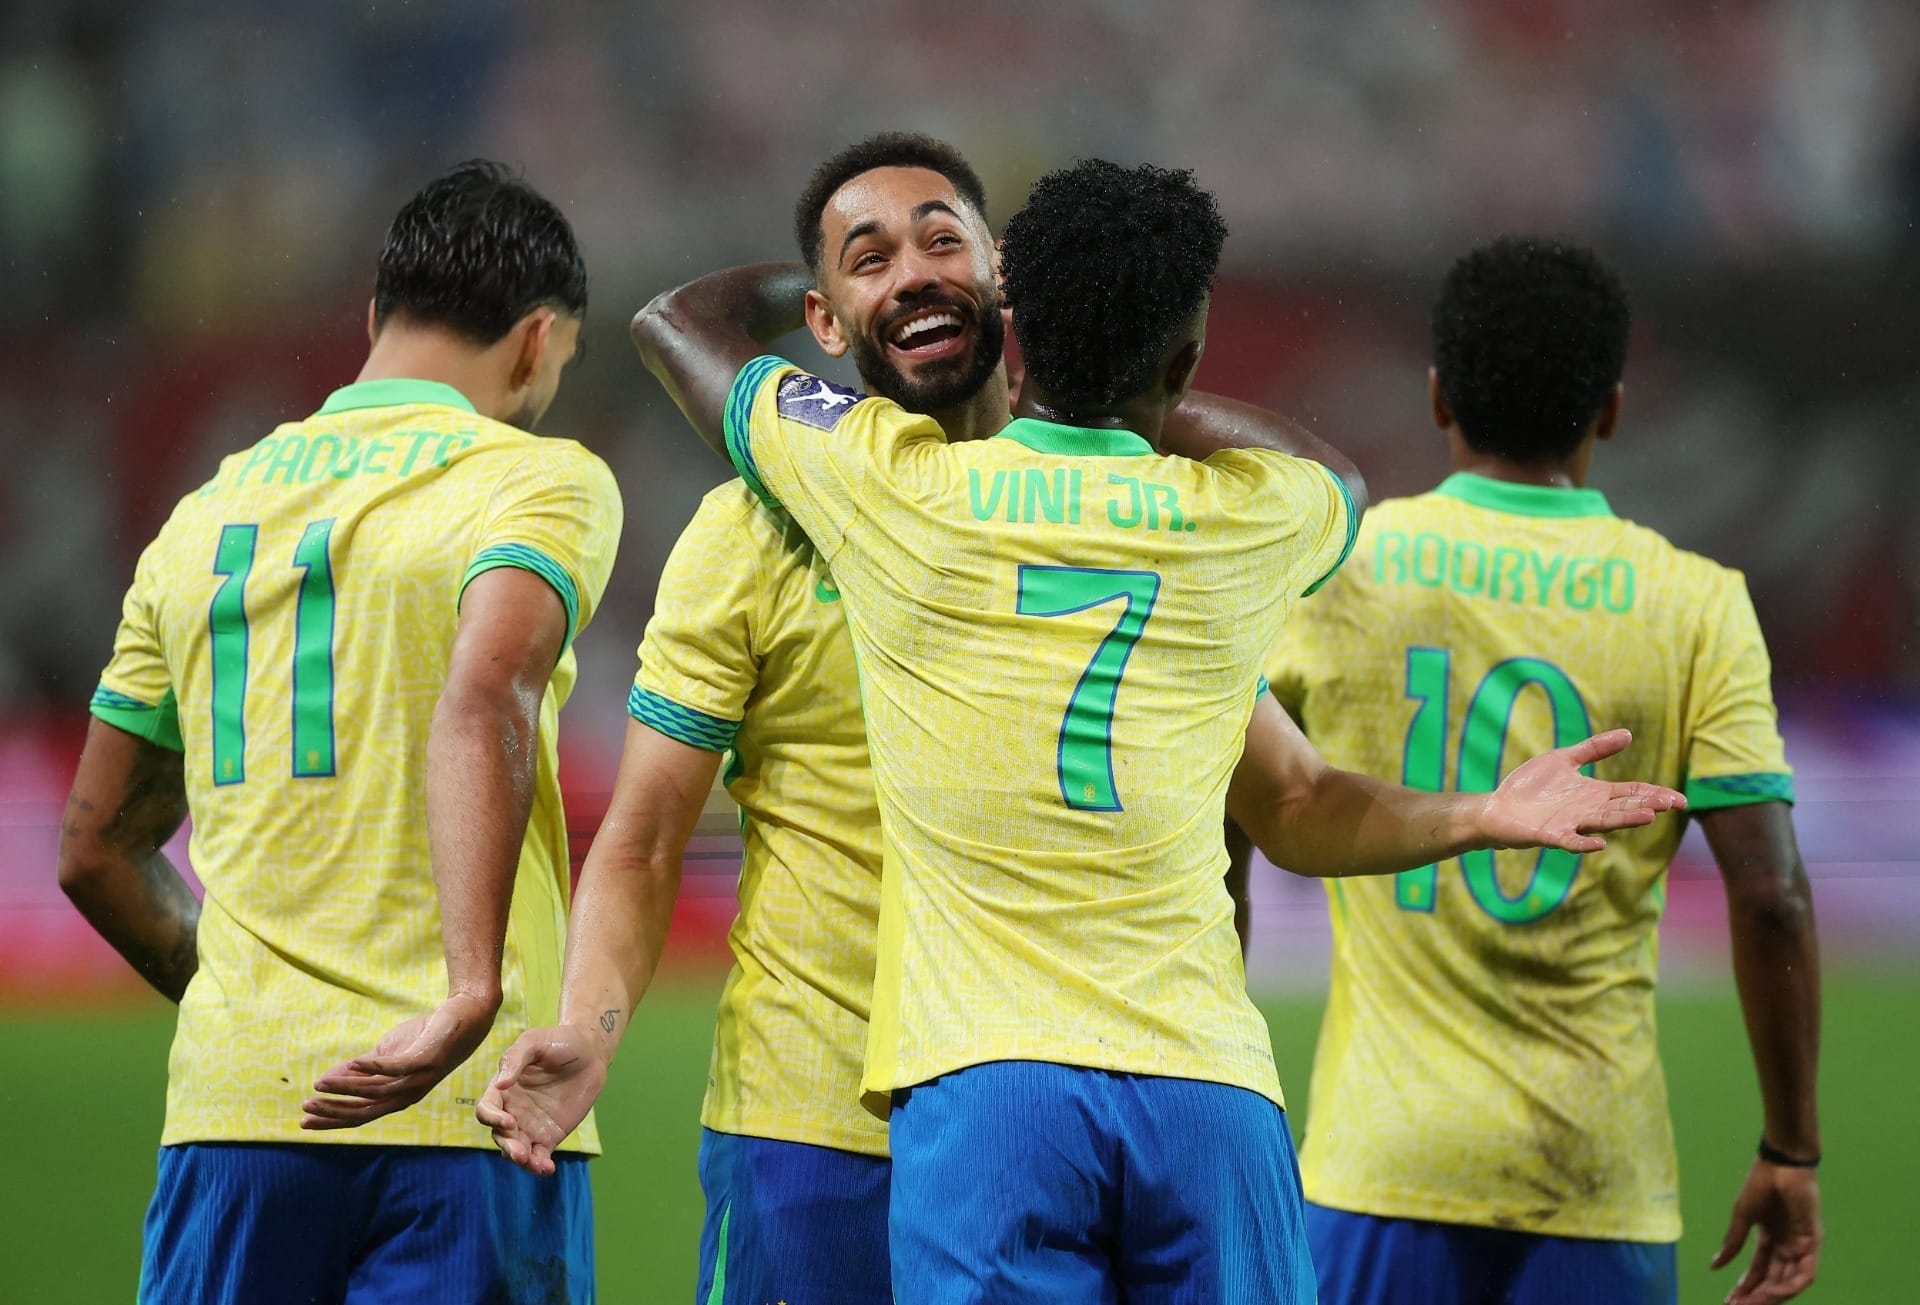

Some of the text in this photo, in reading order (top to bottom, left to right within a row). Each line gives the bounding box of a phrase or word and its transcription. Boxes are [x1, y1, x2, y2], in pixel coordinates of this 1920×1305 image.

[968, 468, 1197, 532] VINI JR.
[1374, 530, 1636, 614] RODRYGO
[208, 517, 337, 787] 11
[1016, 565, 1161, 812] 7
[1395, 645, 1595, 926] 10
